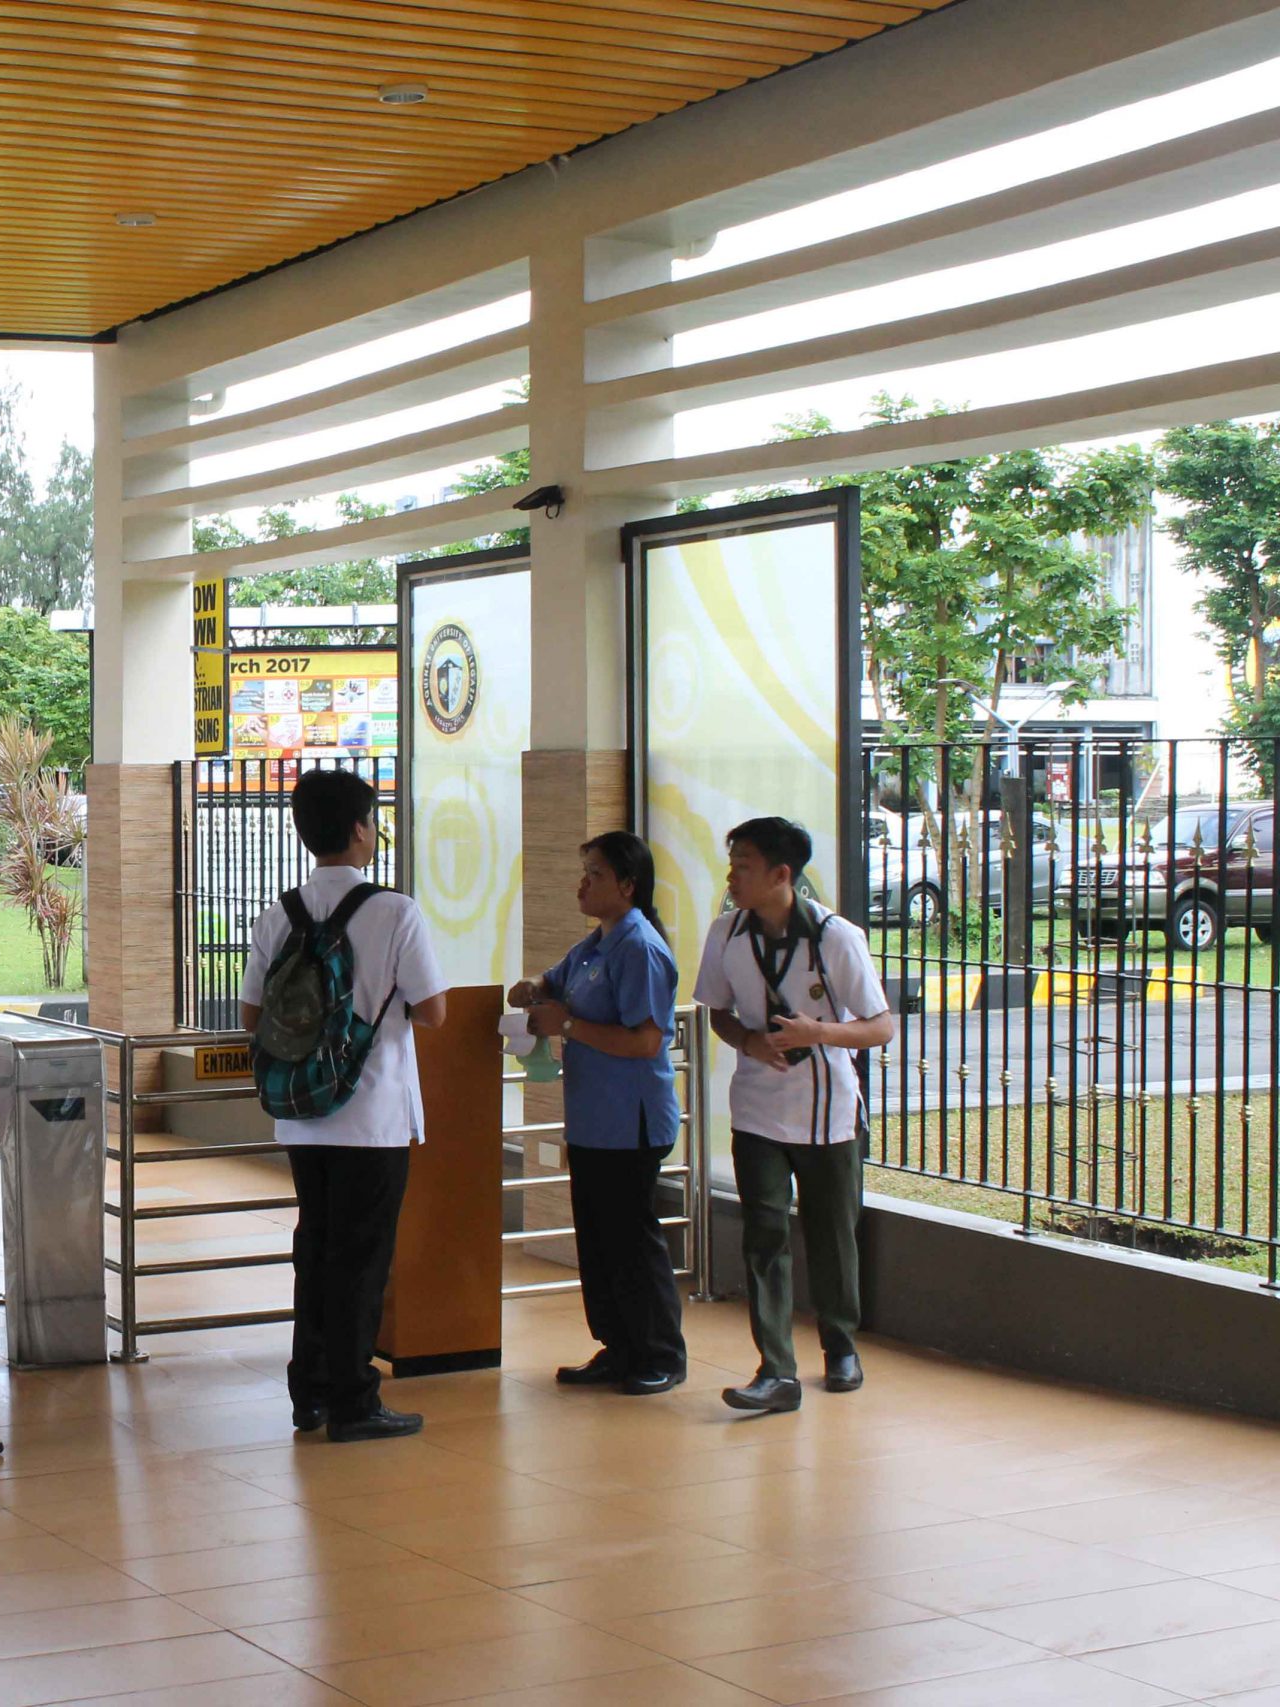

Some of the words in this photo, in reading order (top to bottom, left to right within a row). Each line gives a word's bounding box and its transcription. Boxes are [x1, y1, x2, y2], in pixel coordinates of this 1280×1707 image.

[194, 583, 216, 613] OW
[194, 616, 216, 646] WN
[230, 658, 261, 674] rch
[266, 657, 311, 673] 2017
[430, 627, 462, 652] UNIVERSITY
[467, 655, 476, 705] LEGAZPI
[194, 685, 222, 712] STRIAN
[203, 1052, 254, 1073] ENTRANC
